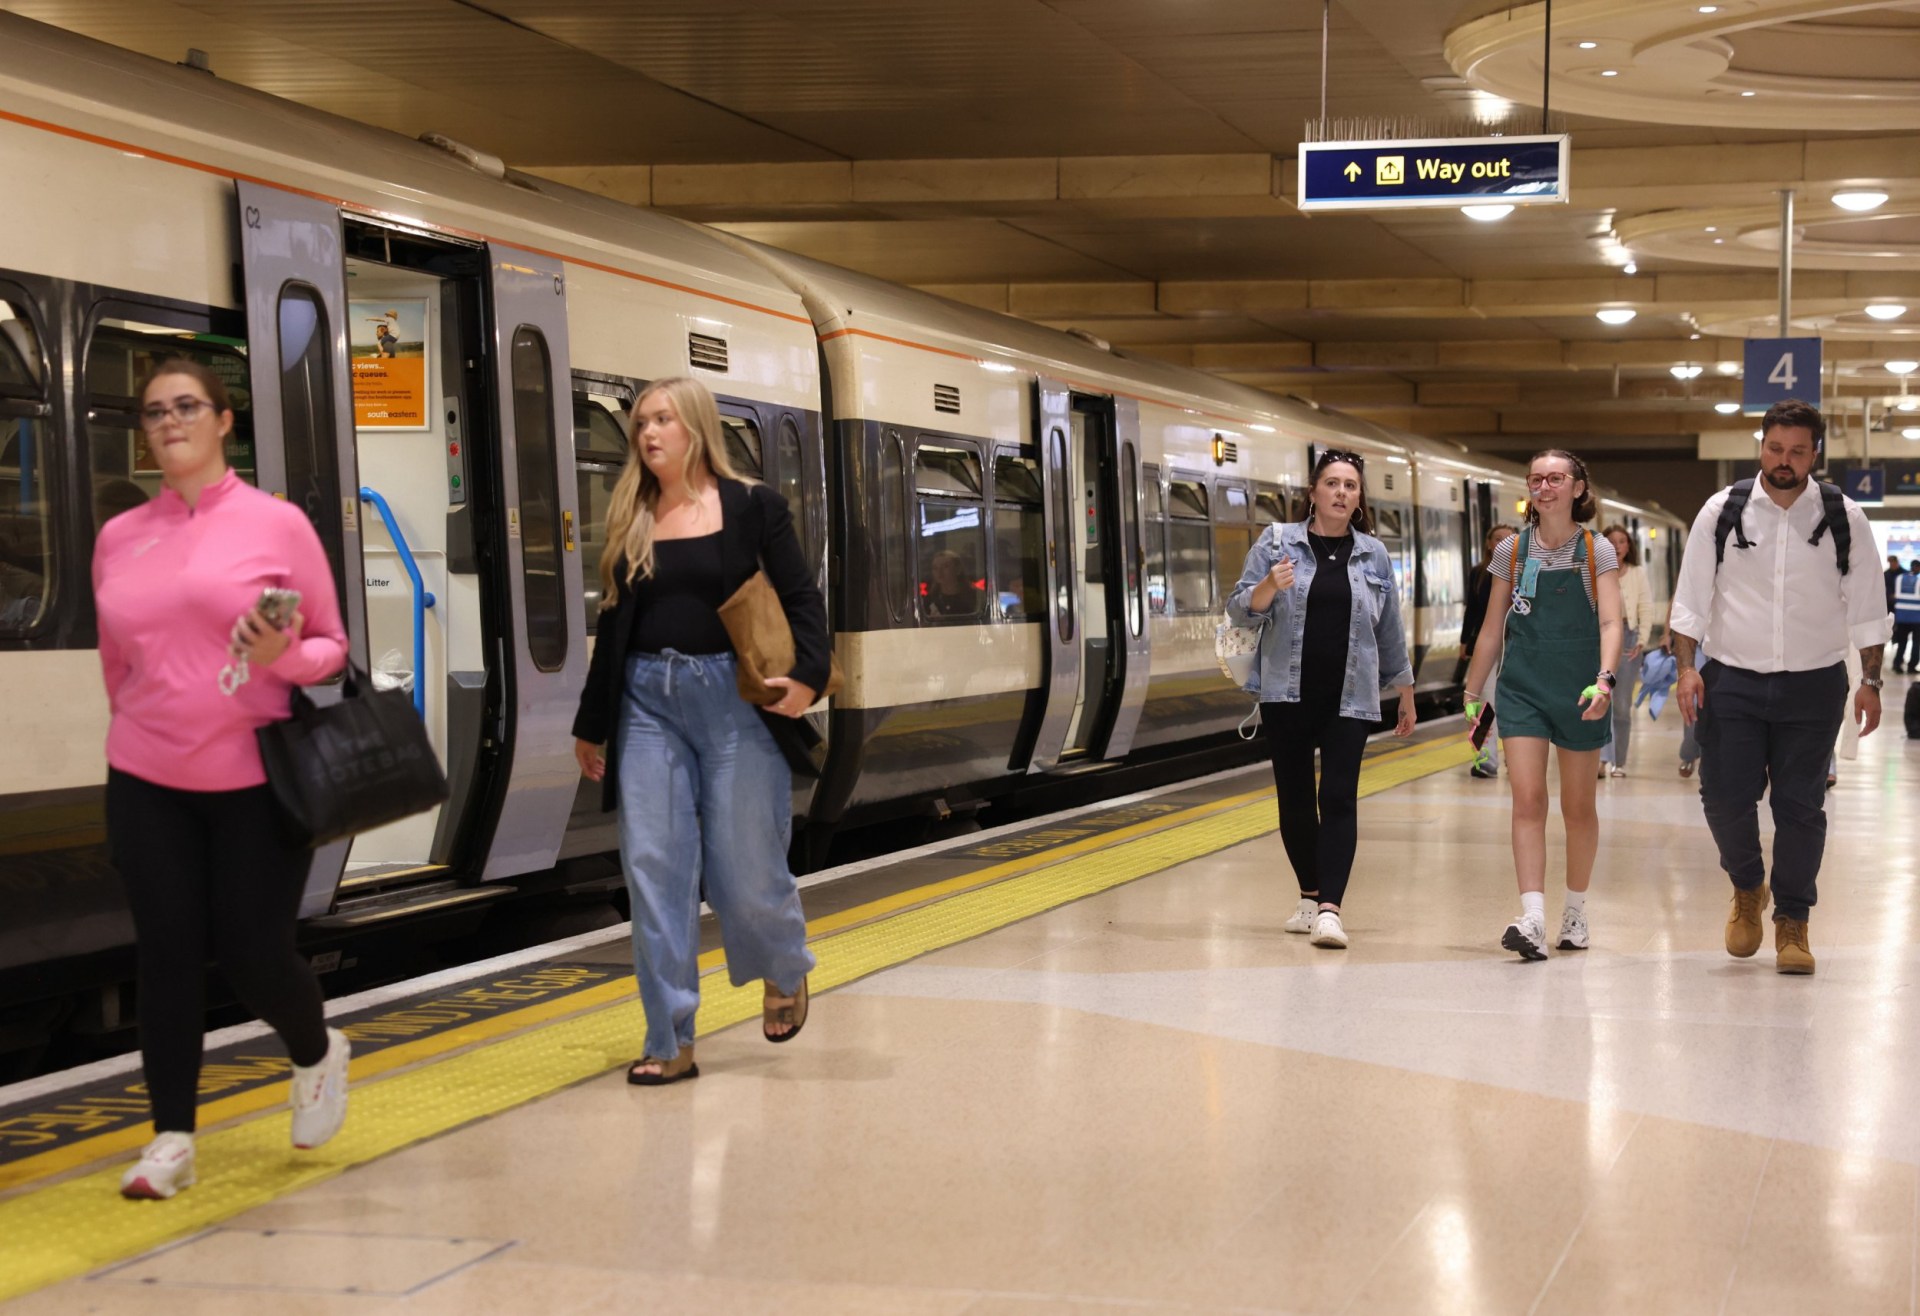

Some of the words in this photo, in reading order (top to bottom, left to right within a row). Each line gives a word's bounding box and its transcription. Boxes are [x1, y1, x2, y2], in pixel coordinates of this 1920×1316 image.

[1416, 158, 1466, 184] Way
[1471, 158, 1511, 179] out
[246, 206, 262, 230] C2
[553, 276, 564, 297] C1
[1767, 352, 1798, 391] 4
[1855, 474, 1873, 495] 4
[366, 578, 390, 588] Litter
[341, 1010, 472, 1042] MIND
[417, 988, 549, 1010] THE
[493, 967, 609, 990] GAP
